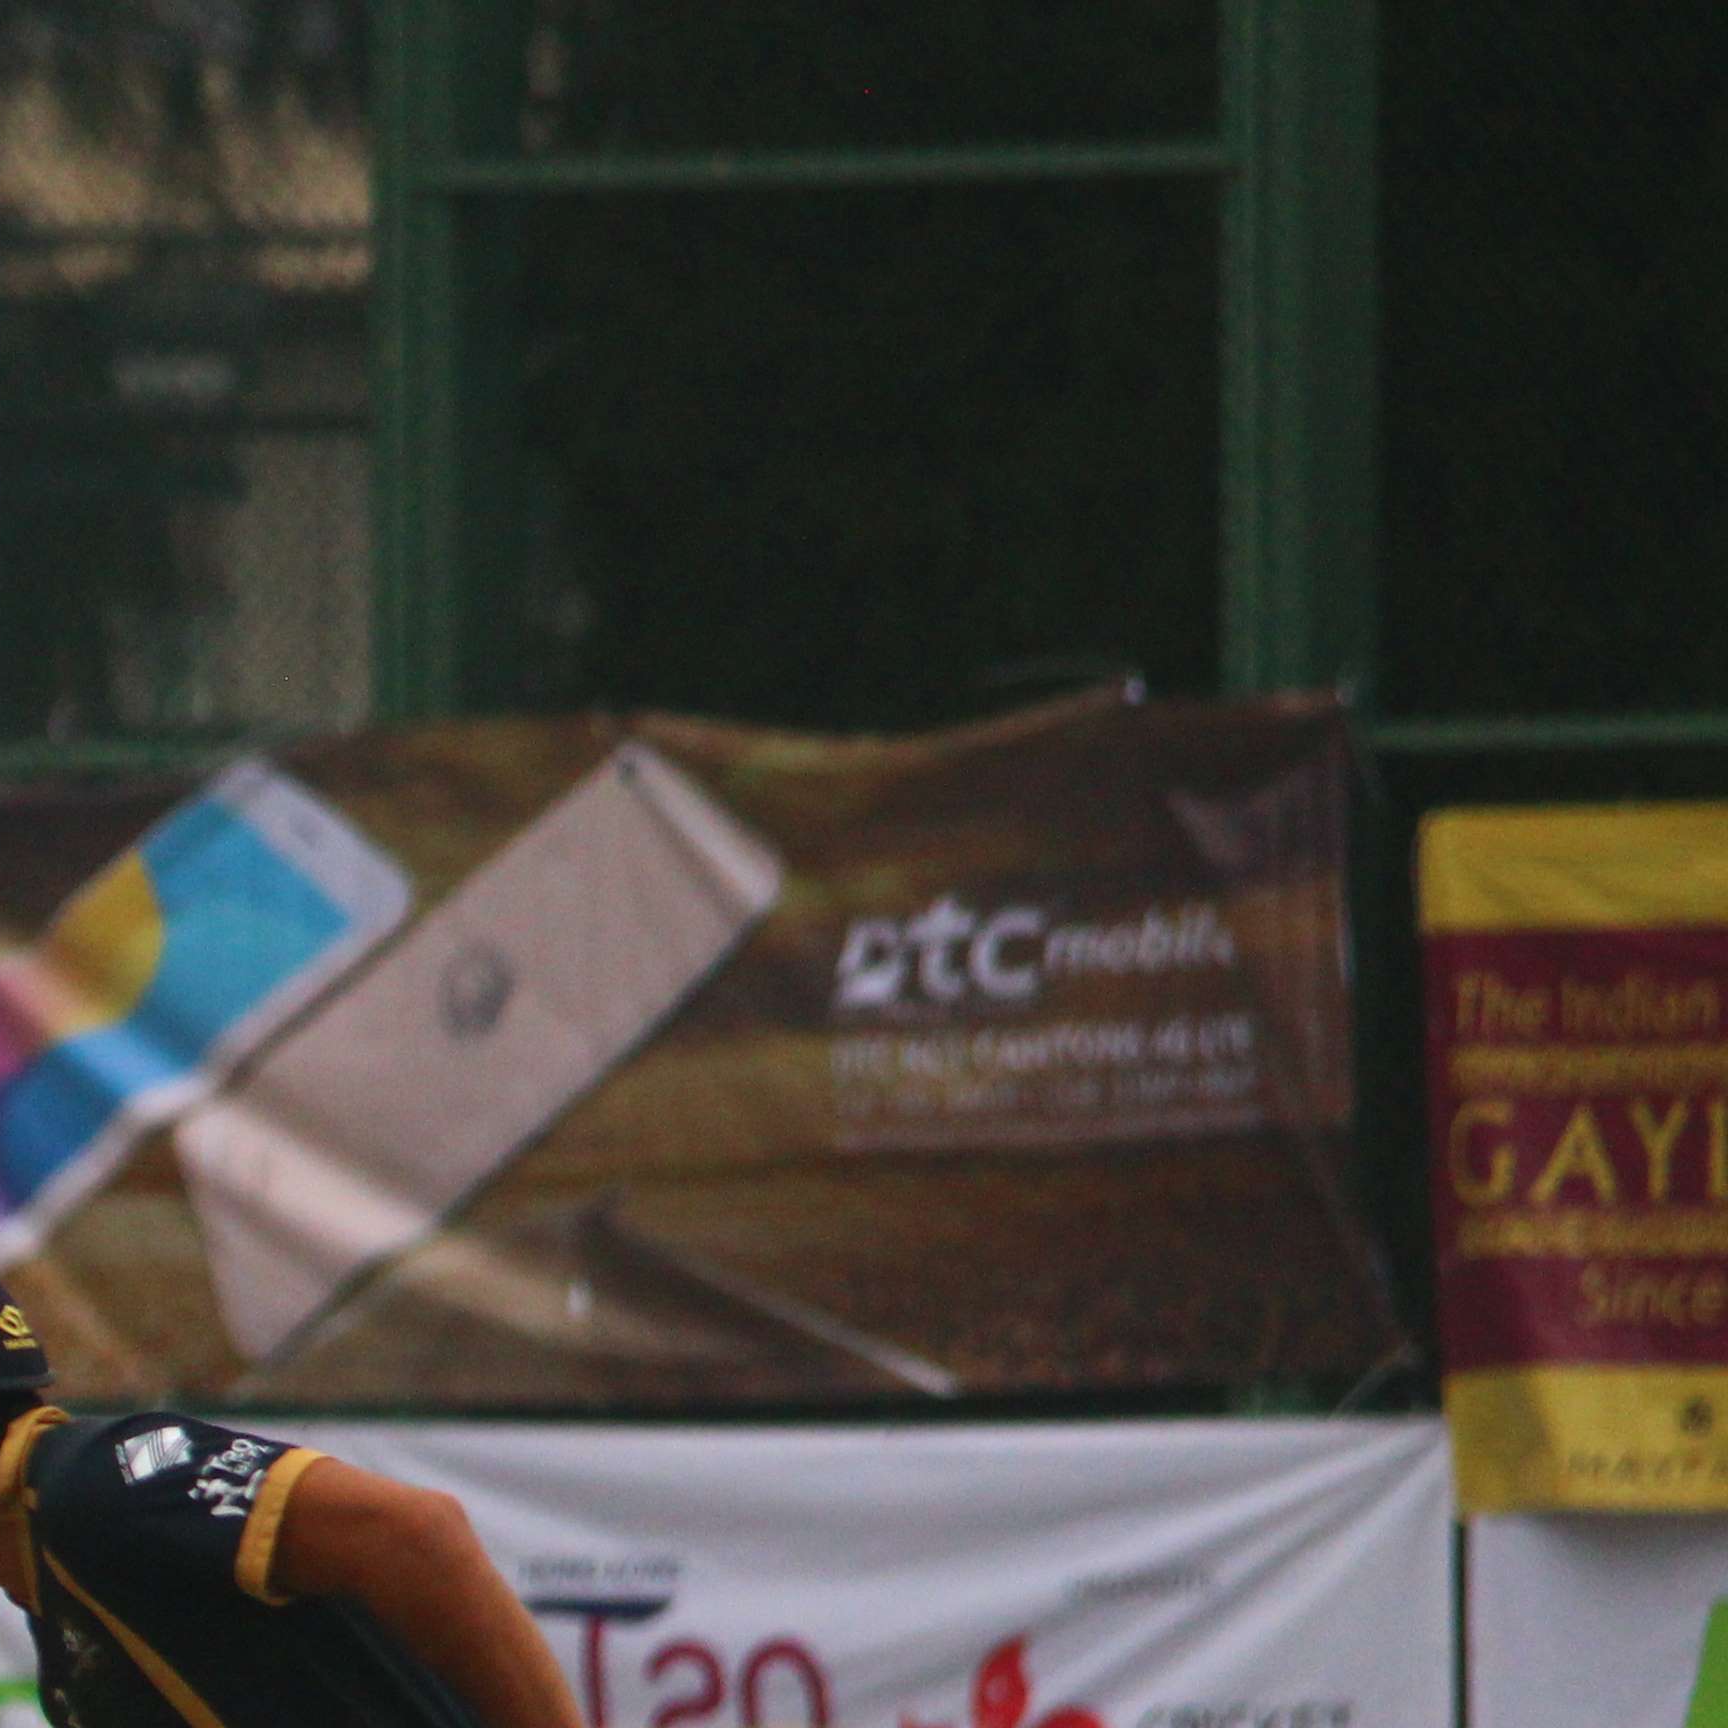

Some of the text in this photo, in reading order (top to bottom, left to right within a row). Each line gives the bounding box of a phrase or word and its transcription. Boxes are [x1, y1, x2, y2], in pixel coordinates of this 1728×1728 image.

[1046, 908, 1236, 976] mobile
[1560, 970, 1721, 1040] Indian
[1579, 1260, 1725, 1330] Since
